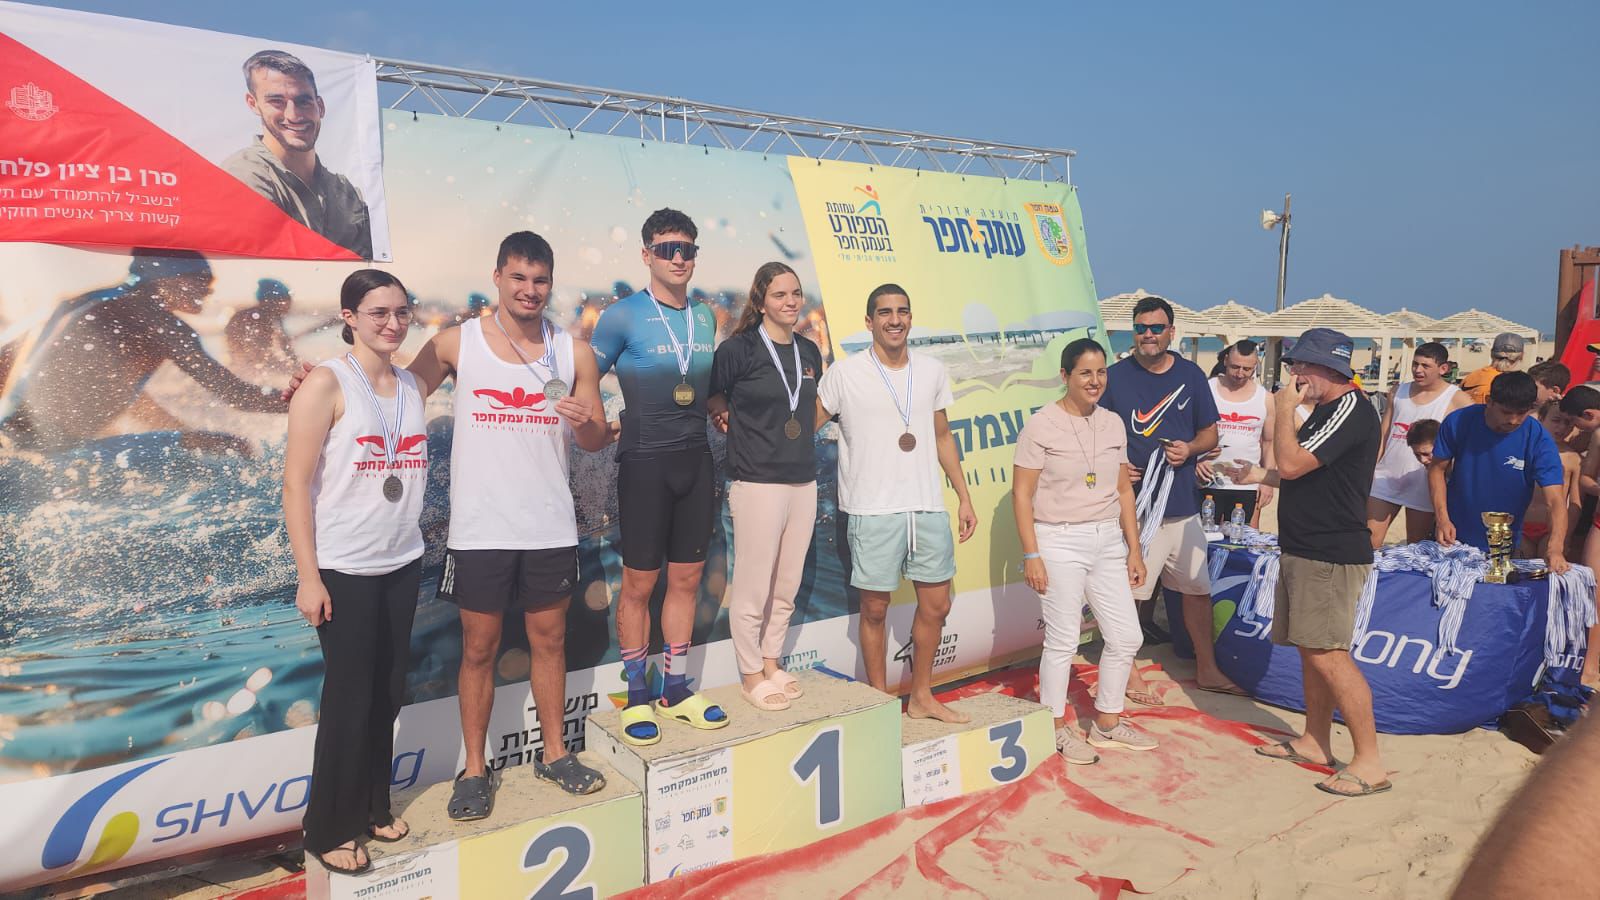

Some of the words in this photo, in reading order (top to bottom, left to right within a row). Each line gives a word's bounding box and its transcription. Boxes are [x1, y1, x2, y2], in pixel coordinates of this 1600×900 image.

[0, 157, 51, 178] פלח
[58, 162, 100, 181] ציון
[108, 165, 132, 184] בן
[139, 169, 177, 187] סרן
[21, 186, 45, 200] עם
[50, 187, 121, 204] להתמודד
[44, 206, 94, 221] אנשים
[100, 208, 134, 223] צריך
[825, 201, 855, 214] עמותת
[979, 208, 1019, 221] מועצה
[140, 211, 181, 227] קשות
[828, 213, 890, 236] הספורט
[833, 234, 860, 251] חפר
[922, 216, 980, 253] חפר
[976, 219, 1026, 259] עמק
[860, 236, 894, 253] בעמק
[471, 412, 497, 423] חפר
[498, 413, 524, 425] עמק
[525, 414, 560, 425] משחה
[948, 409, 1024, 462] עמק
[353, 460, 377, 471] חפר
[378, 459, 403, 472] עק
[782, 649, 818, 666] תיירות
[989, 720, 1027, 782] 3
[699, 766, 728, 782] משחה
[793, 729, 841, 825] 1
[657, 782, 677, 795] חפר
[677, 775, 699, 790] עמק
[524, 826, 594, 900] 2
[400, 867, 432, 883] משחה
[353, 885, 376, 898] חפר
[376, 878, 399, 893] עמק
